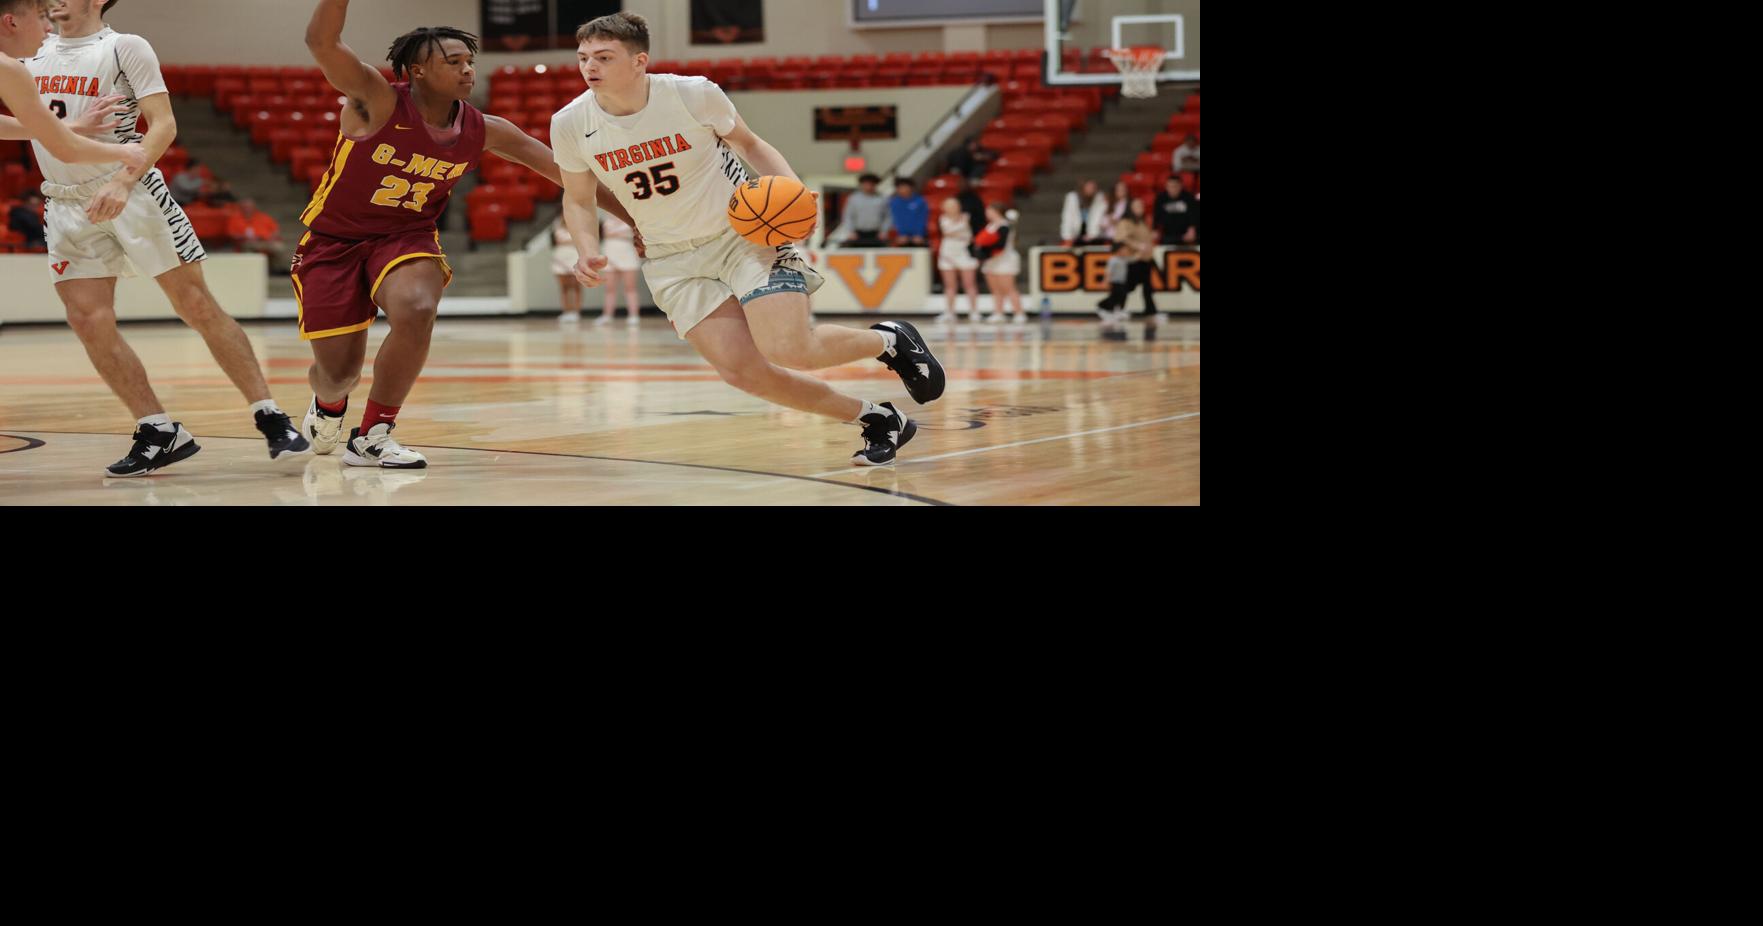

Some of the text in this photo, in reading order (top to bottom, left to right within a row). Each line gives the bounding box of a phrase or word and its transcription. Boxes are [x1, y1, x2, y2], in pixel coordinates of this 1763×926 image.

[594, 133, 692, 172] VIRGINIA
[370, 175, 435, 212] 23
[624, 161, 680, 200] 35
[51, 260, 69, 275] V
[827, 254, 912, 310] V
